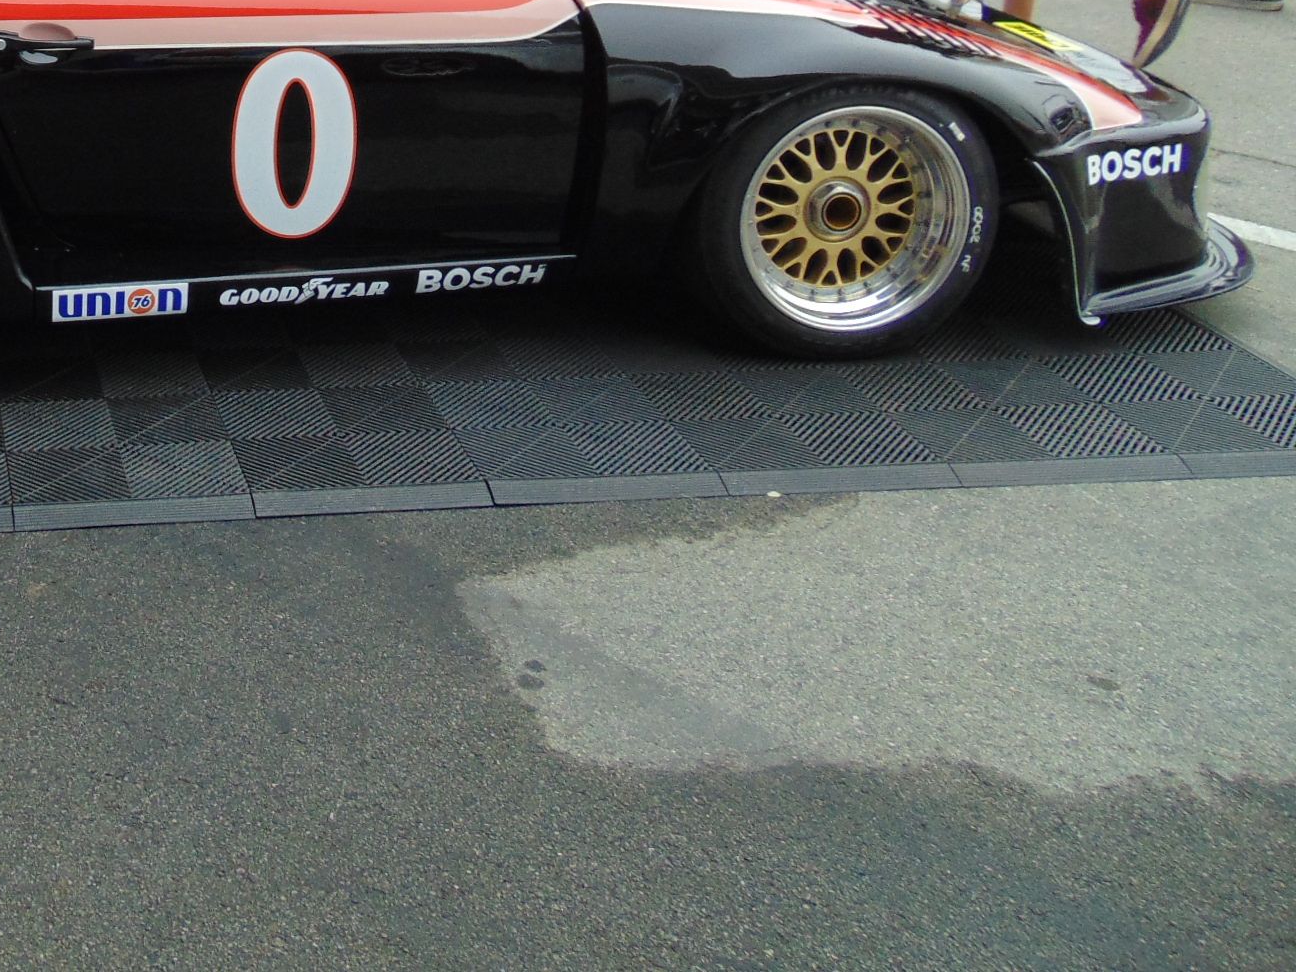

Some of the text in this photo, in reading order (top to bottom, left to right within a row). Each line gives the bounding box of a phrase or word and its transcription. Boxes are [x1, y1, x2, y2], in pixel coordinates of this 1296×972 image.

[231, 47, 358, 239] 0
[1088, 143, 1184, 186] BOSCH
[415, 263, 546, 294] BOSCH
